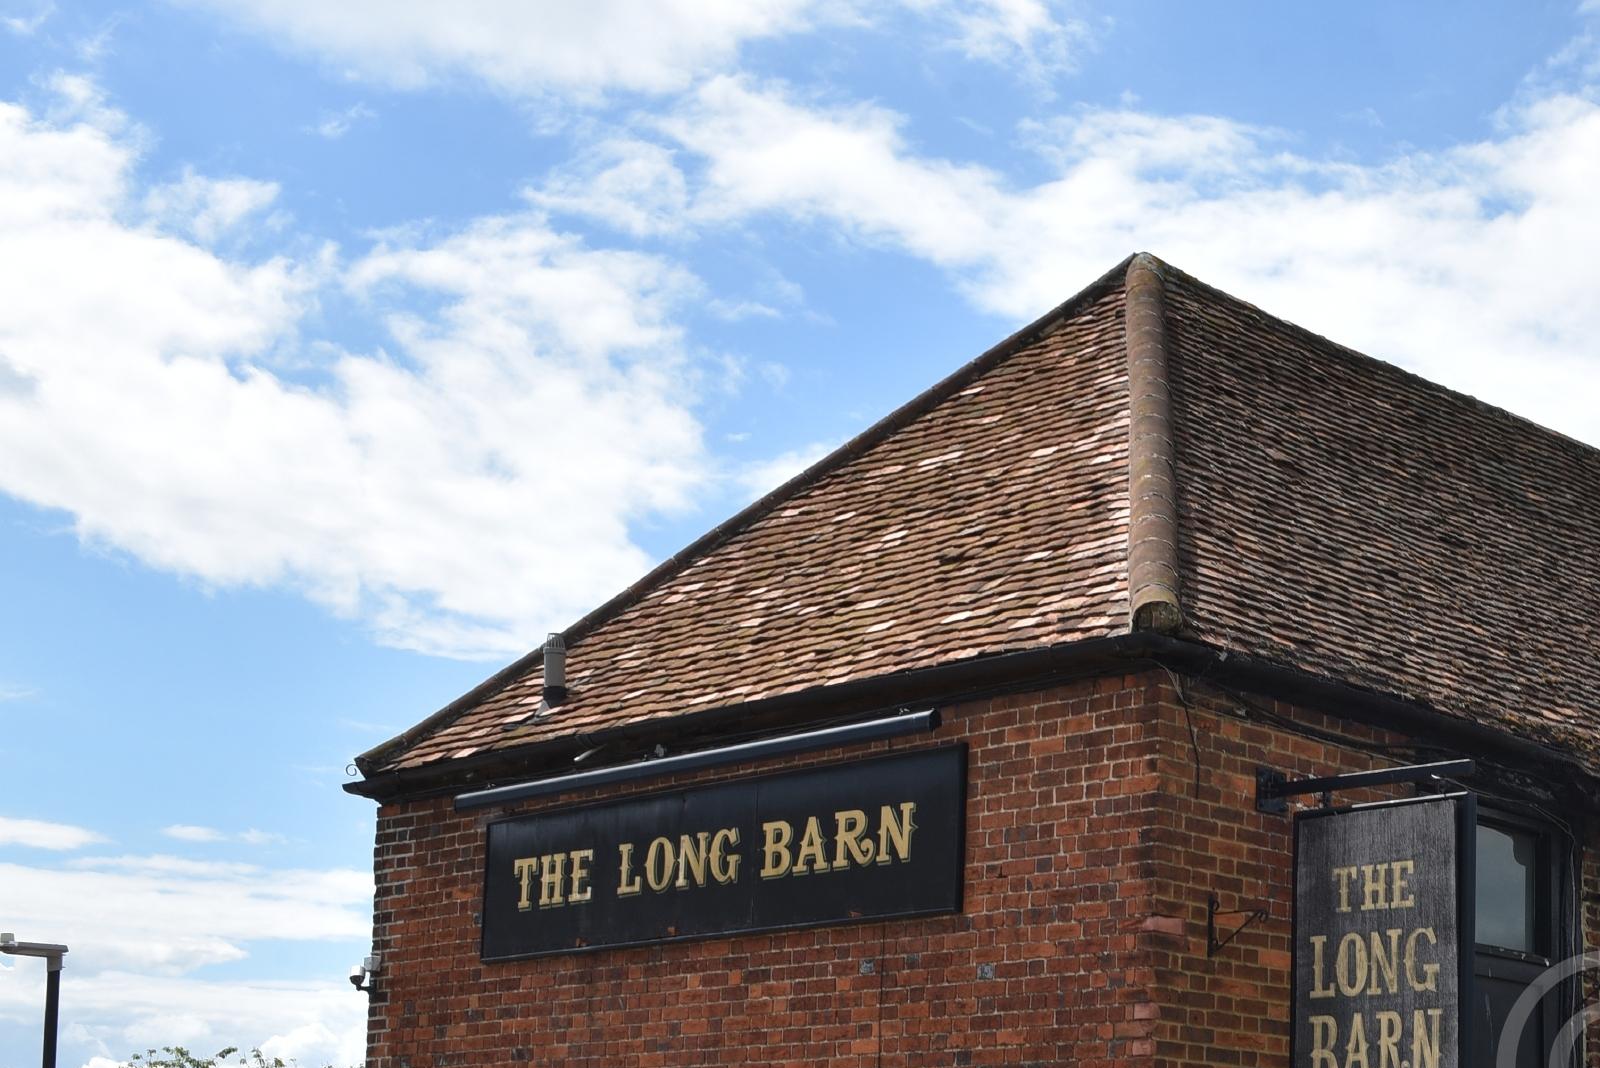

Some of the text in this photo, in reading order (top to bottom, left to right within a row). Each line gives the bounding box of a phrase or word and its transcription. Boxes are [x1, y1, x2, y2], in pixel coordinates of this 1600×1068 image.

[514, 802, 918, 911] THE LONG BARN
[1332, 860, 1415, 913] THE
[1310, 927, 1440, 999] LONG
